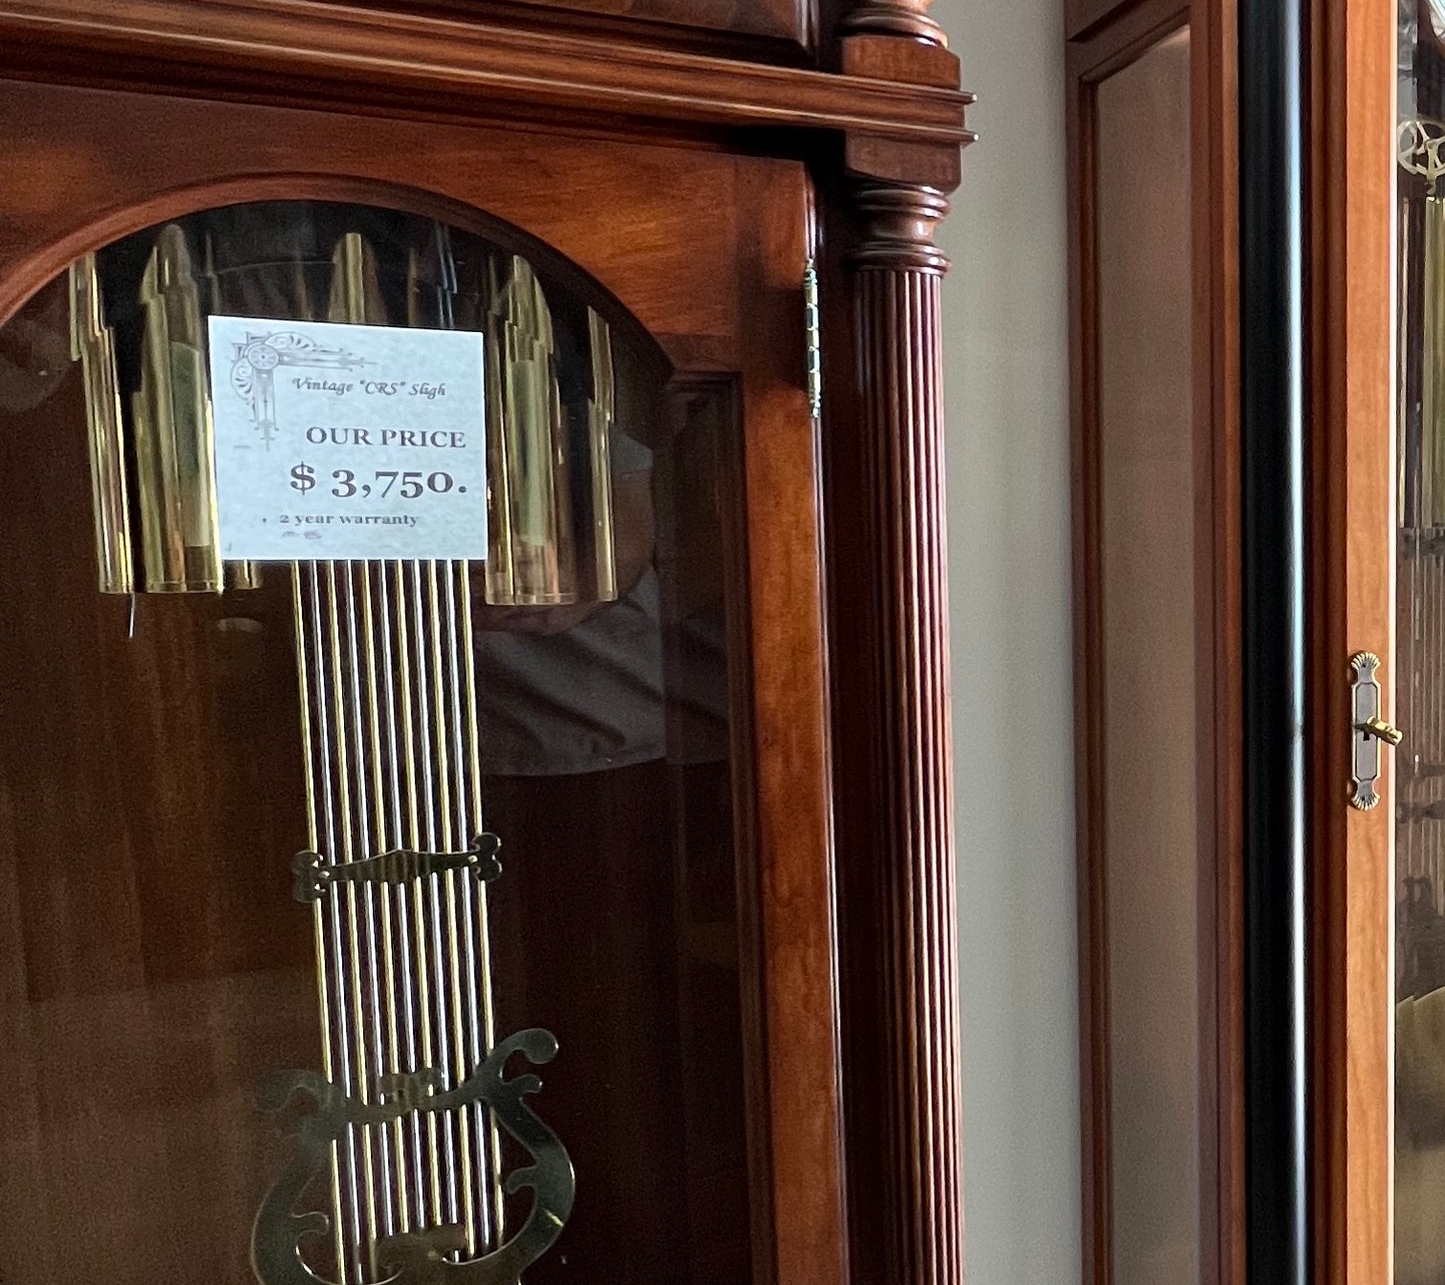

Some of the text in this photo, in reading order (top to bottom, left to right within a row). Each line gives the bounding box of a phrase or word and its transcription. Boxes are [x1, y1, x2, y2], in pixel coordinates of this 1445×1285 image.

[291, 376, 353, 396] Vintage
[306, 425, 467, 448] OUR PRICE
[294, 514, 334, 527] year
[338, 514, 417, 528] warranty
